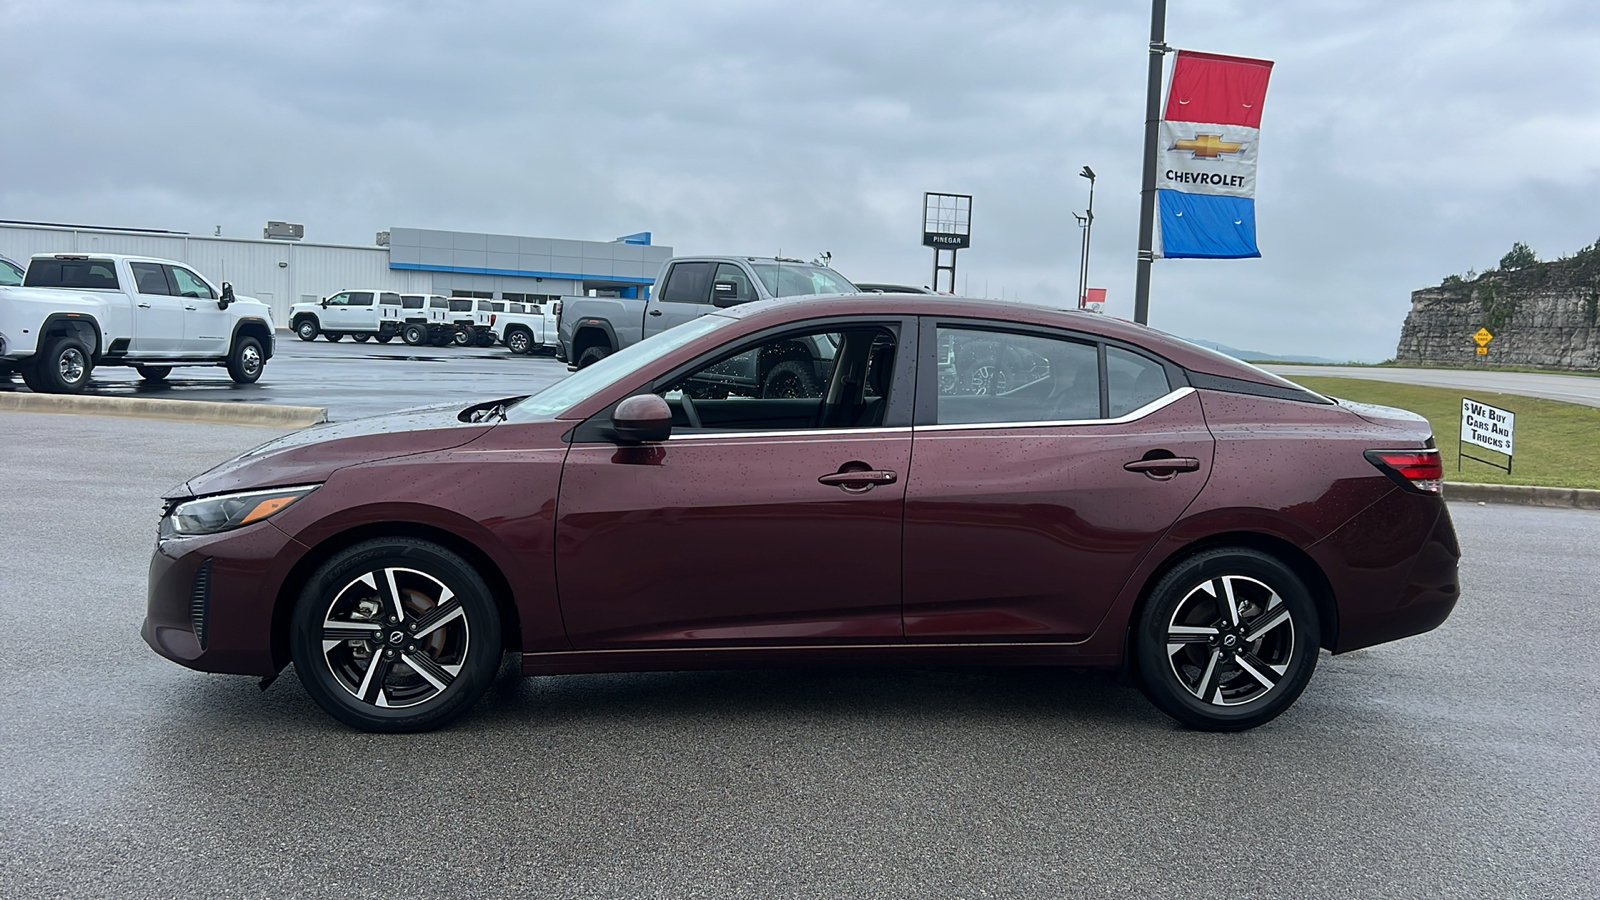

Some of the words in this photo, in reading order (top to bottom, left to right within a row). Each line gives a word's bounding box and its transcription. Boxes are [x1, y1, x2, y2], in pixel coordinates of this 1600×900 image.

[1166, 170, 1245, 188] CHEVROLET
[933, 236, 961, 244] PINEGAR
[1466, 415, 1489, 431] CARS
[1491, 423, 1509, 437] AND
[1471, 429, 1503, 448] TRUCKS
